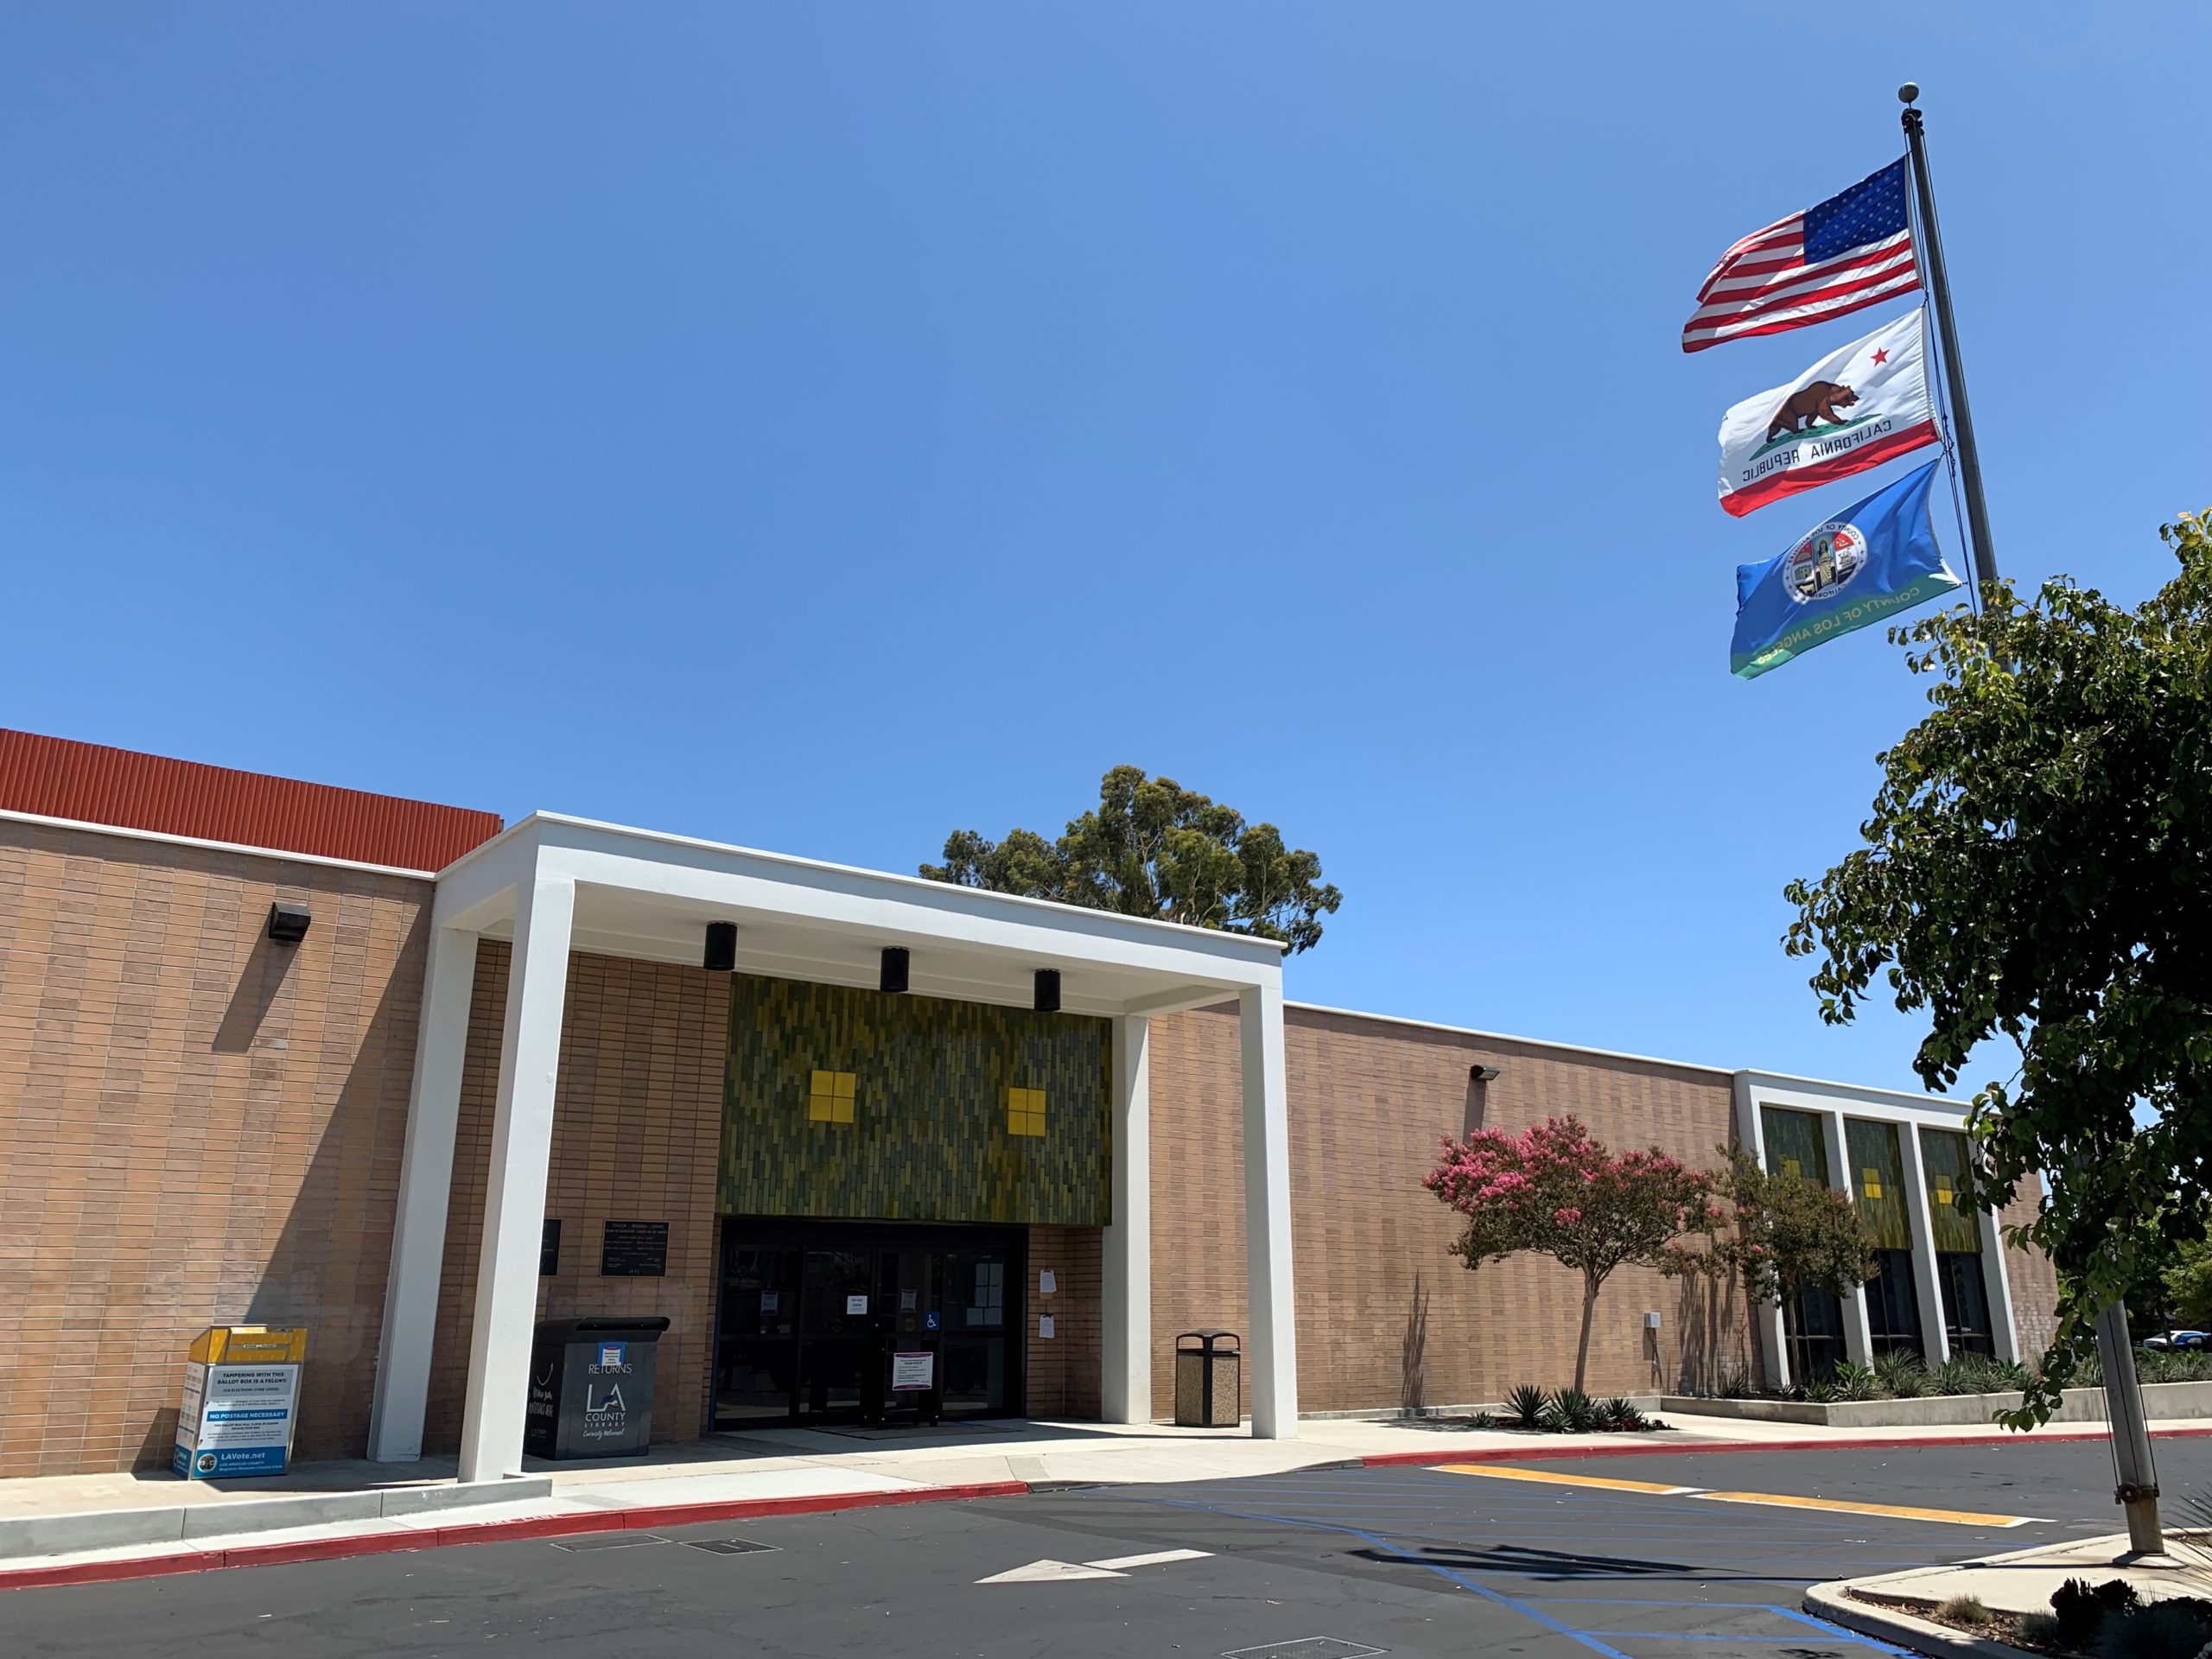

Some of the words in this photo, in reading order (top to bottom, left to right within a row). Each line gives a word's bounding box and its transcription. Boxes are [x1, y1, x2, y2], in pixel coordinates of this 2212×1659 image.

[588, 1363, 632, 1374] RETURNS
[587, 1383, 626, 1412] LA
[585, 1413, 626, 1421] COUNTY
